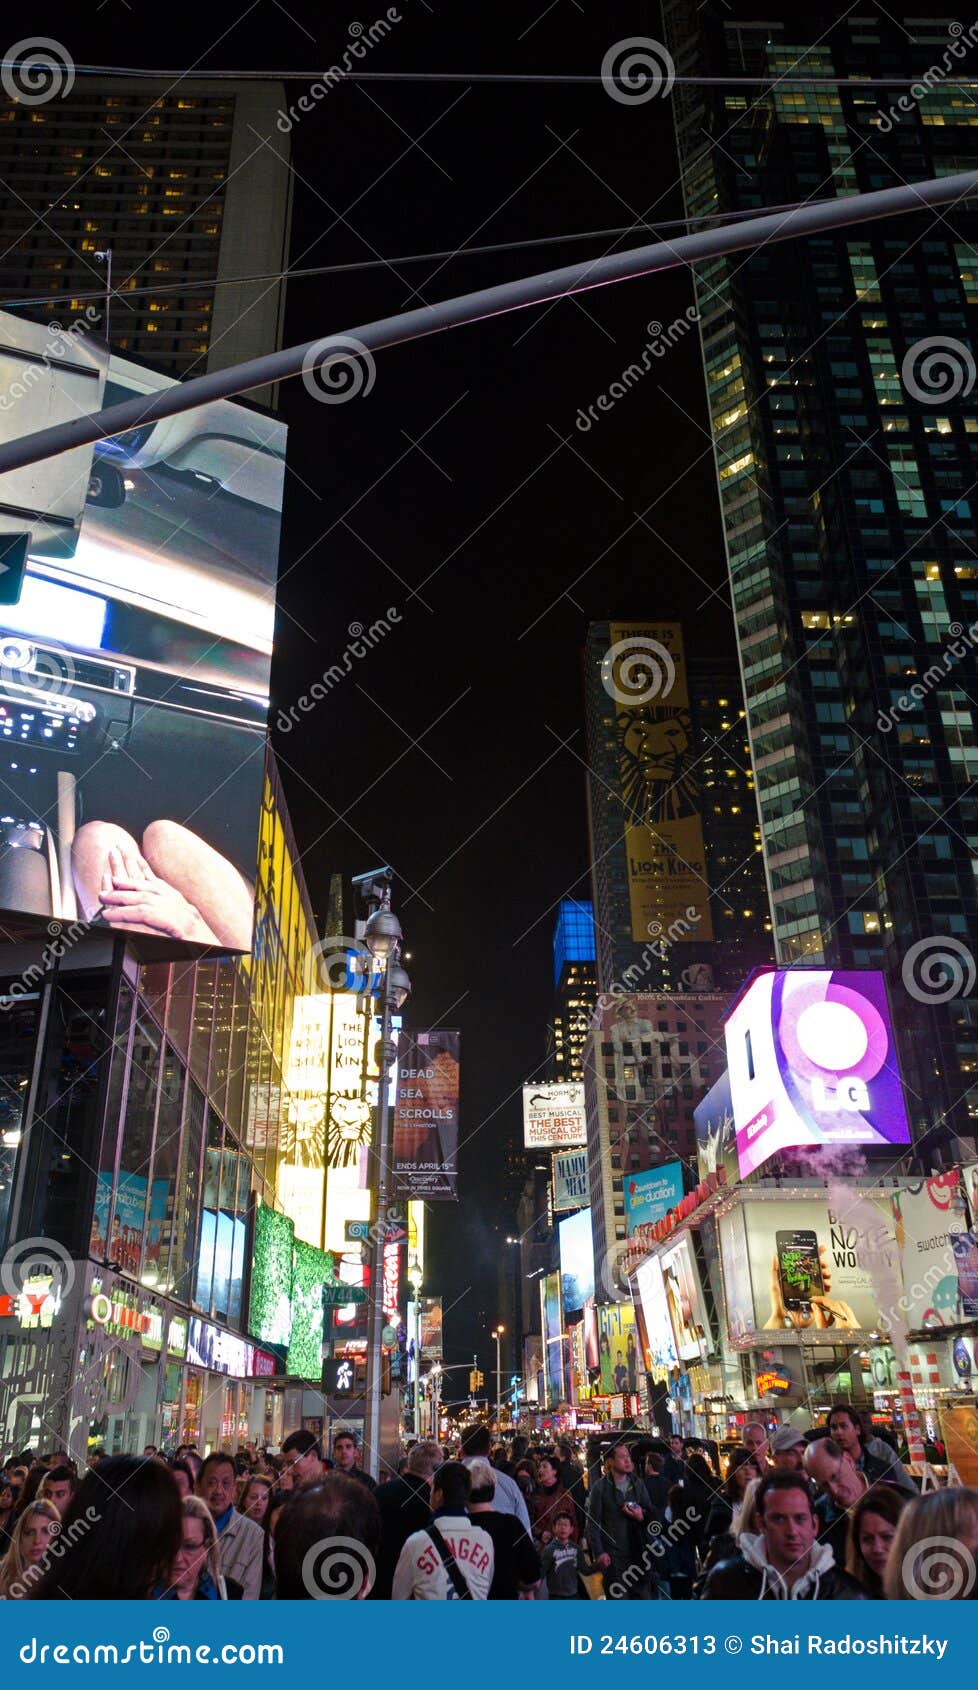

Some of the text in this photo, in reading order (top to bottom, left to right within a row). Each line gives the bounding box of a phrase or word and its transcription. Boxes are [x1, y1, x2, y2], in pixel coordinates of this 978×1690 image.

[336, 1052, 363, 1069] KIN
[401, 1069, 434, 1079] DEAD
[400, 1089, 423, 1098] SEA
[811, 1077, 870, 1111] LG
[400, 1109, 453, 1119] SCROLLS
[529, 1117, 582, 1128] THE BEST
[529, 1128, 568, 1136] MUSICAL
[338, 1290, 352, 1301] 44
